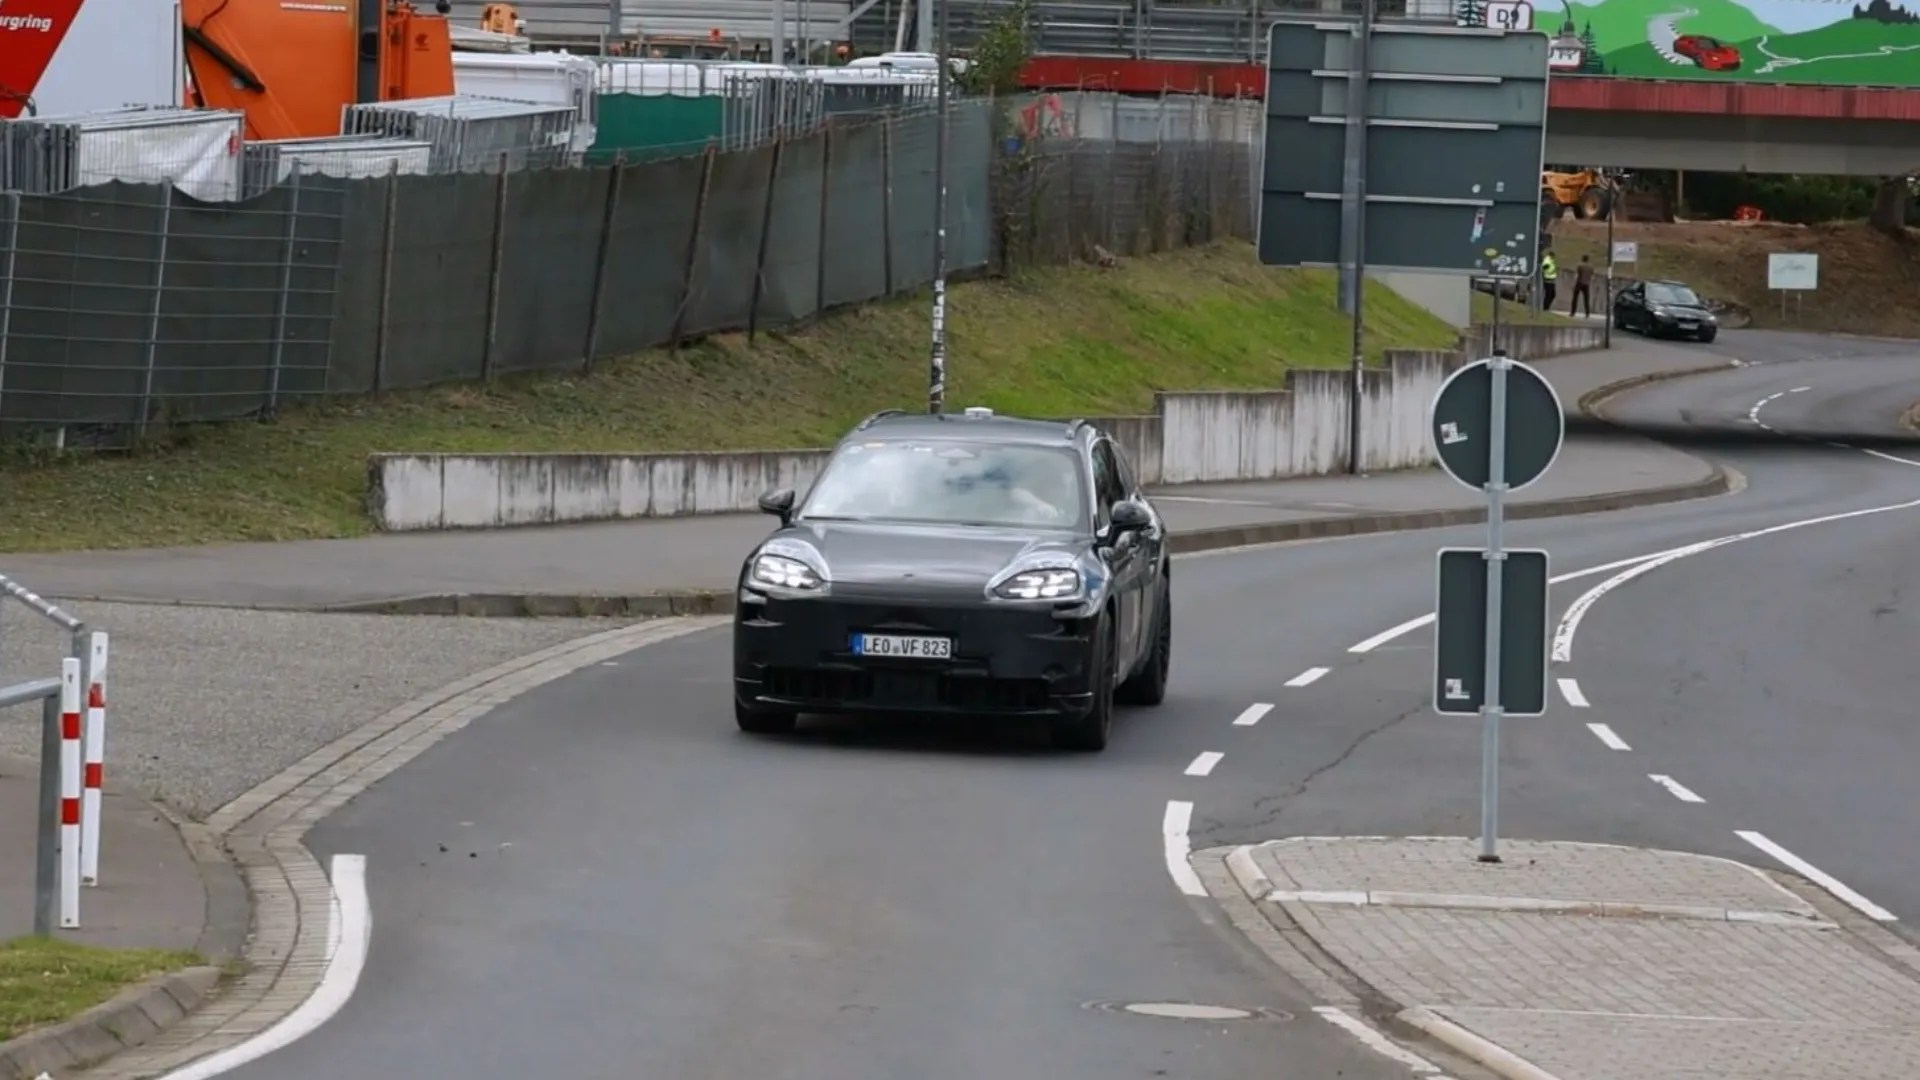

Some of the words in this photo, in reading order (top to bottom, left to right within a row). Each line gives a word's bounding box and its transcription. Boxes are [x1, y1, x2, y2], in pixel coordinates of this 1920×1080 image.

[863, 637, 891, 653] LEO
[901, 639, 919, 655] VF
[922, 640, 949, 656] 823
